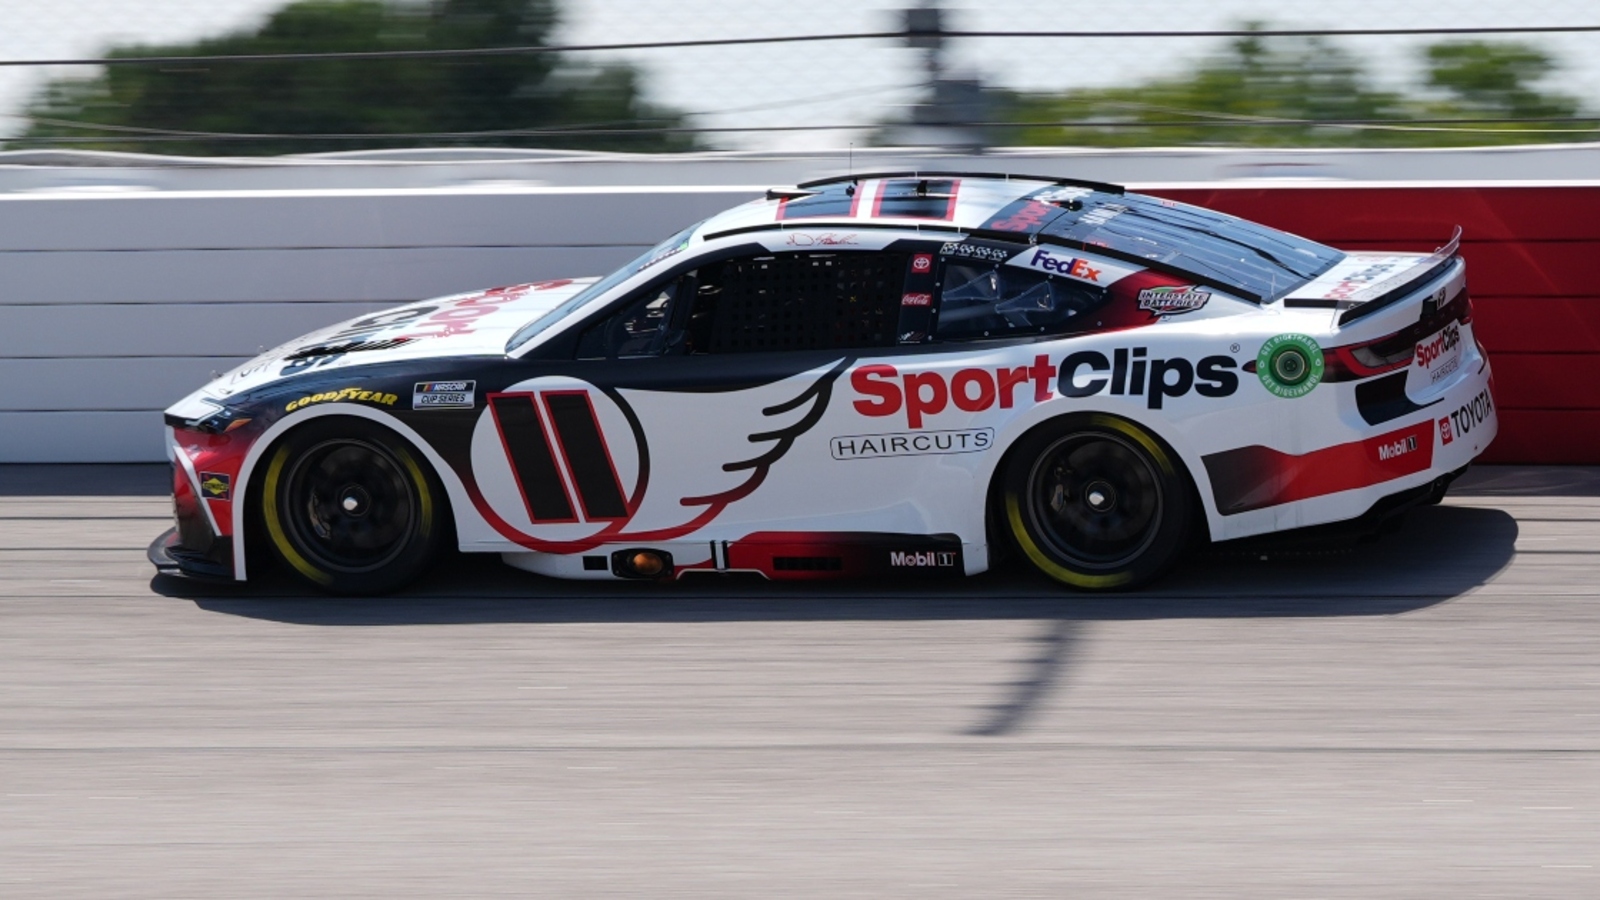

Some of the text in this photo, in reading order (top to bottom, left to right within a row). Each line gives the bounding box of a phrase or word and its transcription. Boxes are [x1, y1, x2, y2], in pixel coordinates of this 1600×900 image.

[1030, 249, 1102, 282] FedEx
[1142, 291, 1204, 300] INTERSTATE
[1144, 299, 1200, 307] BATTERIES
[1416, 325, 1460, 369] SportClips
[285, 387, 398, 412] GOODYEAR
[421, 394, 466, 404] CUP SERIES
[850, 347, 1239, 429] SportClips
[1451, 388, 1493, 438] TOYOTA
[838, 432, 989, 456] HAIRCUTS
[1378, 439, 1407, 461] Mobil
[486, 389, 631, 525] 11
[890, 552, 935, 566] Mobil
